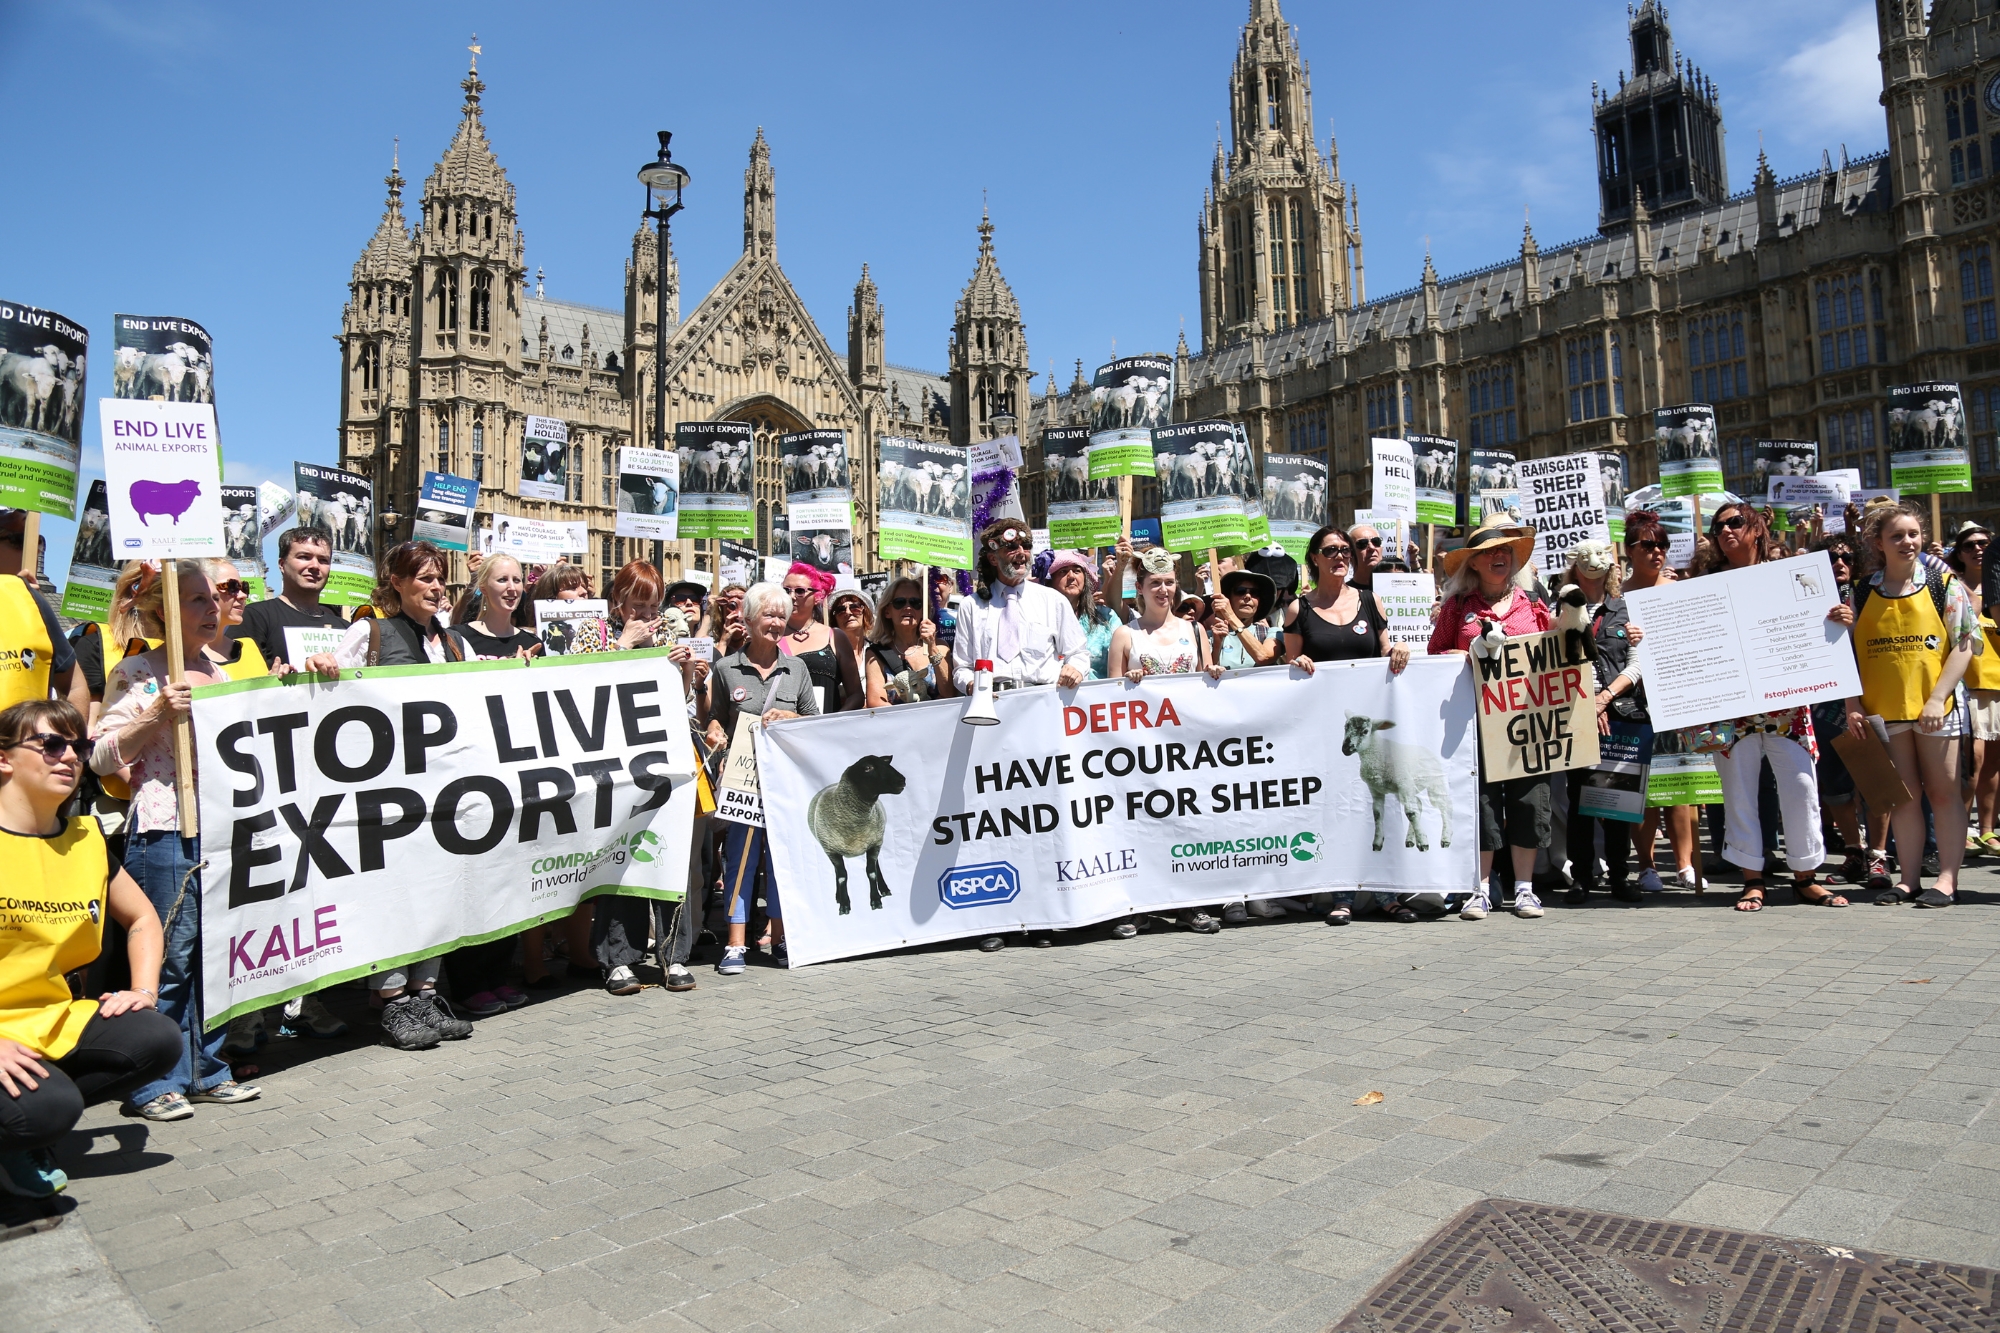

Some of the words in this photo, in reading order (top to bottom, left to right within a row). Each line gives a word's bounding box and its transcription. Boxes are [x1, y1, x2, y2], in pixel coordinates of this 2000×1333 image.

[19, 309, 51, 329] LIVE
[123, 319, 149, 330] END
[152, 321, 177, 331] LIVE
[1099, 366, 1113, 376] END
[1115, 361, 1132, 371] LIVE
[1134, 360, 1170, 373] EXPORTS
[1892, 387, 1910, 396] END
[1912, 385, 1931, 394] LIVE
[114, 419, 159, 437] END
[165, 421, 208, 440] LIVE
[534, 423, 557, 432] DOVER
[680, 425, 696, 433] END
[698, 425, 714, 433] LIVE
[716, 426, 750, 435] EXPORTS
[1156, 429, 1175, 439] END
[1177, 426, 1196, 437] LIVE
[784, 435, 797, 444] END
[799, 432, 812, 441] LIVE
[813, 431, 842, 439] EXPORTS
[1048, 431, 1065, 440] END
[1067, 430, 1084, 439] LIVE
[115, 442, 159, 453] ANIMAL
[162, 443, 208, 454] EXPORTS
[886, 438, 905, 448] END
[907, 442, 926, 452] LIVE
[928, 445, 967, 459] EXPORTS
[24, 464, 42, 474] how
[43, 469, 53, 477] you
[1268, 456, 1284, 464] END
[1285, 457, 1302, 465] LIVE
[1303, 458, 1326, 472] EXPORTS
[1521, 456, 1589, 477] RAMSGATE
[19, 473, 34, 481] and
[300, 466, 319, 477] END
[321, 471, 340, 482] LIVE
[341, 474, 372, 491] EXPORTS
[1384, 466, 1411, 480] HELL
[433, 482, 451, 490] HELP
[452, 485, 468, 493] END
[1532, 472, 1586, 495] SHEEP
[220, 489, 256, 498] XPORTS
[441, 495, 465, 505] transport
[445, 490, 466, 499] distance
[1535, 491, 1590, 514] DEATH
[1525, 509, 1605, 533] HAULAGE
[1134, 529, 1149, 537] END
[1545, 530, 1590, 551] BOSS
[1409, 596, 1432, 604] HERE
[1397, 607, 1431, 617] BLEAT
[1757, 617, 1779, 626] George
[1779, 613, 1799, 621] Eustice
[1766, 625, 1782, 634] Defra
[1783, 621, 1806, 631] Minister
[301, 632, 334, 642] WHAT
[1769, 634, 1788, 643] Nobel
[1788, 631, 1807, 640] House
[1867, 635, 1923, 647] COMPASSION
[303, 645, 319, 653] WE
[1524, 635, 1592, 673] WIL
[1775, 644, 1792, 653] Smith
[1792, 641, 1813, 651] Square
[1781, 653, 1805, 662] London
[1481, 668, 1588, 716] NEVER
[1764, 680, 1838, 699] #stopliveexports
[1062, 697, 1181, 737] DEFRA
[1506, 706, 1574, 746] GIVE
[216, 700, 458, 808] STOP
[485, 680, 668, 764] LIVE
[1612, 742, 1639, 752] distance
[1621, 736, 1640, 745] END
[1521, 738, 1573, 774] UP!
[1609, 750, 1639, 760] transport
[974, 754, 1074, 794] HAVE
[1081, 735, 1274, 779] COURAGE:
[1668, 775, 1682, 783] today
[1694, 775, 1704, 783] you
[1690, 780, 1719, 788] unnecessary
[726, 791, 754, 807] BAN
[932, 802, 1059, 846] STAND
[1070, 794, 1115, 829] UP
[1126, 787, 1202, 821] FOR
[1211, 776, 1322, 814] SHEEP
[228, 750, 672, 910] EXPORTS
[531, 832, 629, 875] COMPASSION
[1170, 835, 1288, 858] COMPASSION
[1054, 848, 1137, 882] KAALE
[1171, 859, 1185, 873] in
[1187, 855, 1229, 872] world
[1232, 851, 1288, 867] farming
[531, 877, 543, 892] in
[545, 866, 588, 888] world
[950, 874, 1010, 897] RSPCA
[531, 890, 558, 902] ciwf.org
[9, 908, 44, 923] world
[45, 912, 91, 926] farming
[229, 904, 342, 979] KALE
[228, 974, 248, 990] KENT
[249, 963, 288, 982] AGAINST
[290, 956, 307, 971] LIVE
[308, 945, 343, 964] EXPORTS
